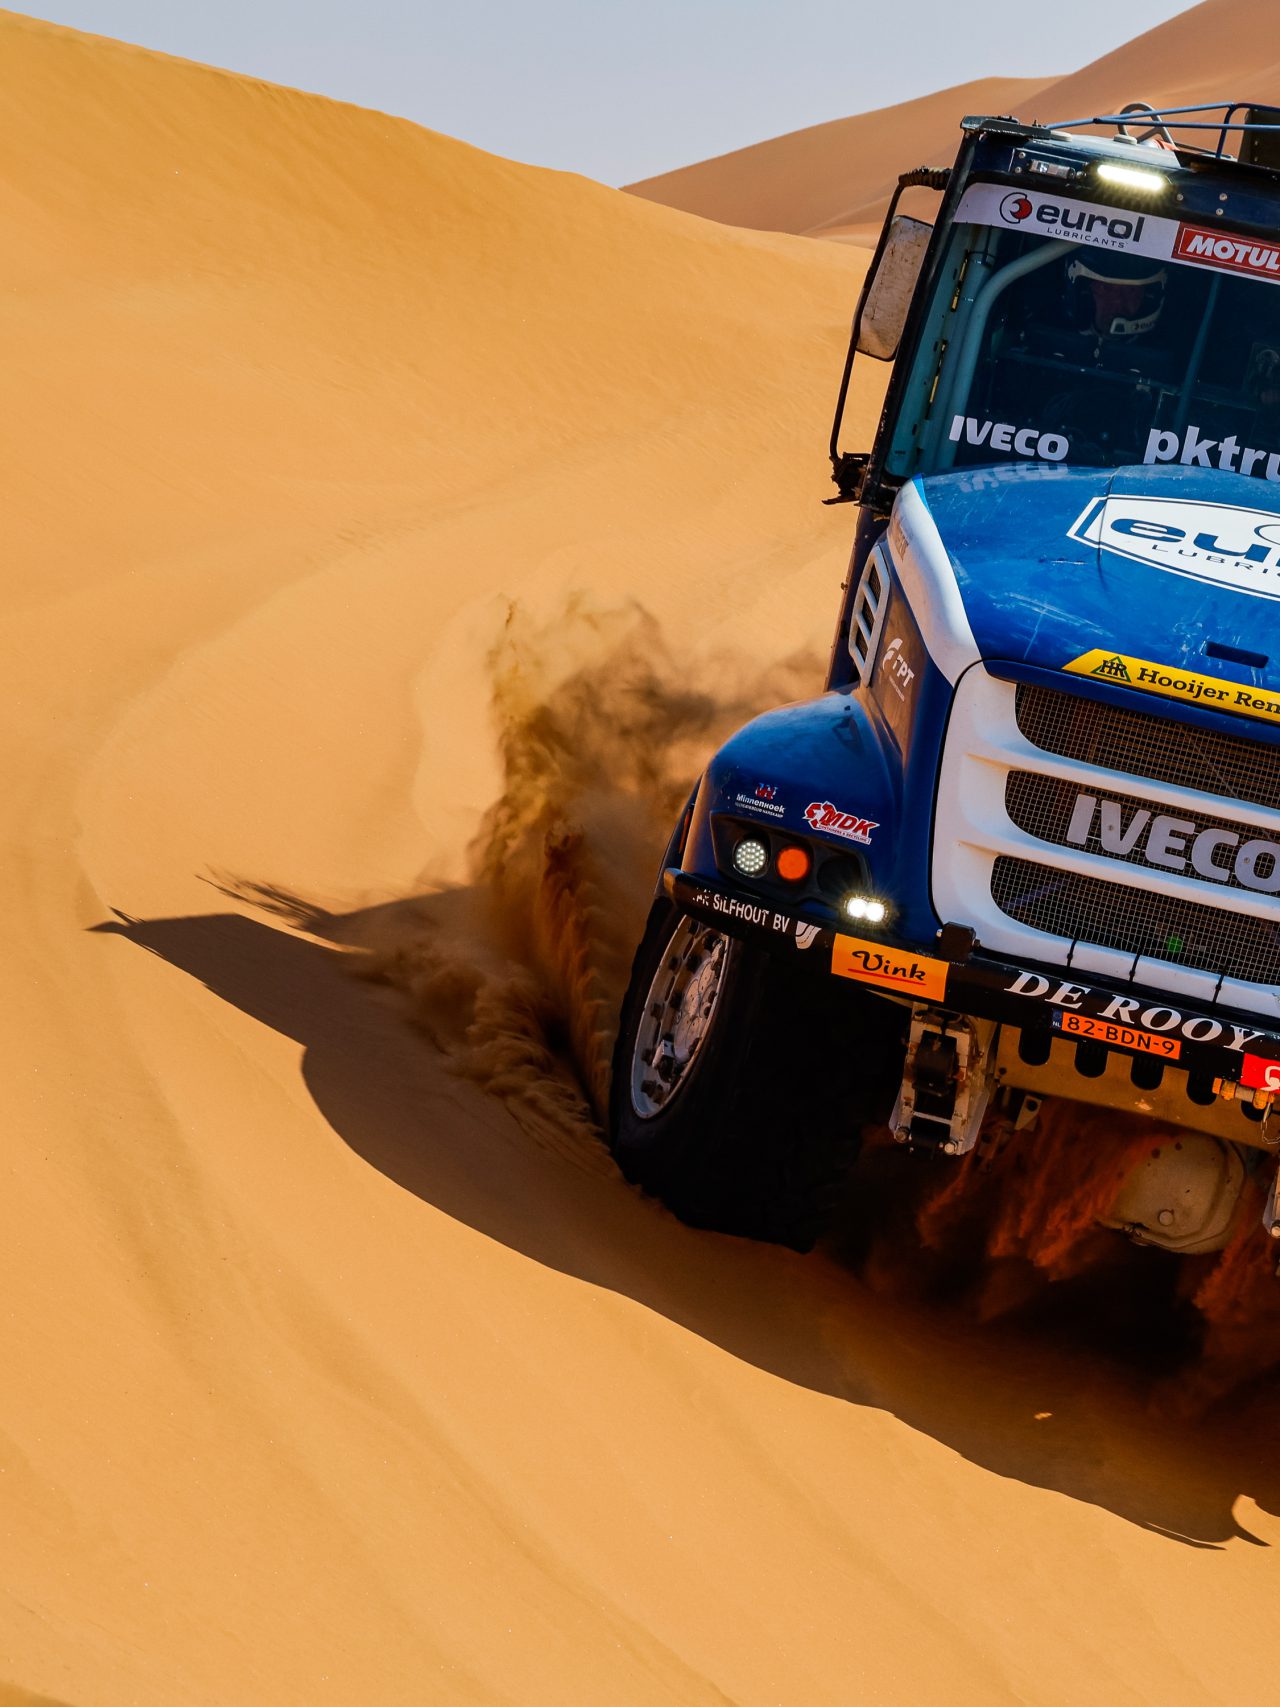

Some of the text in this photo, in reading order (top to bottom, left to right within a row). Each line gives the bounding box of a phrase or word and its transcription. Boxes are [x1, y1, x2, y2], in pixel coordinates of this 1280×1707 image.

[1036, 202, 1145, 243] eurol
[1047, 227, 1126, 249] LUBRICANTS
[1186, 235, 1280, 271] MOTUL
[949, 415, 1070, 462] IVECO
[1136, 667, 1229, 701] Hooijer
[819, 806, 878, 838] MDK
[713, 893, 770, 926] SILFHOUT
[772, 913, 791, 933] BV
[851, 949, 926, 982] Vink
[1004, 970, 1266, 1053] DE ROOY
[1052, 1020, 1061, 1028] NL
[1066, 1016, 1176, 1055] 82-BDN-9
